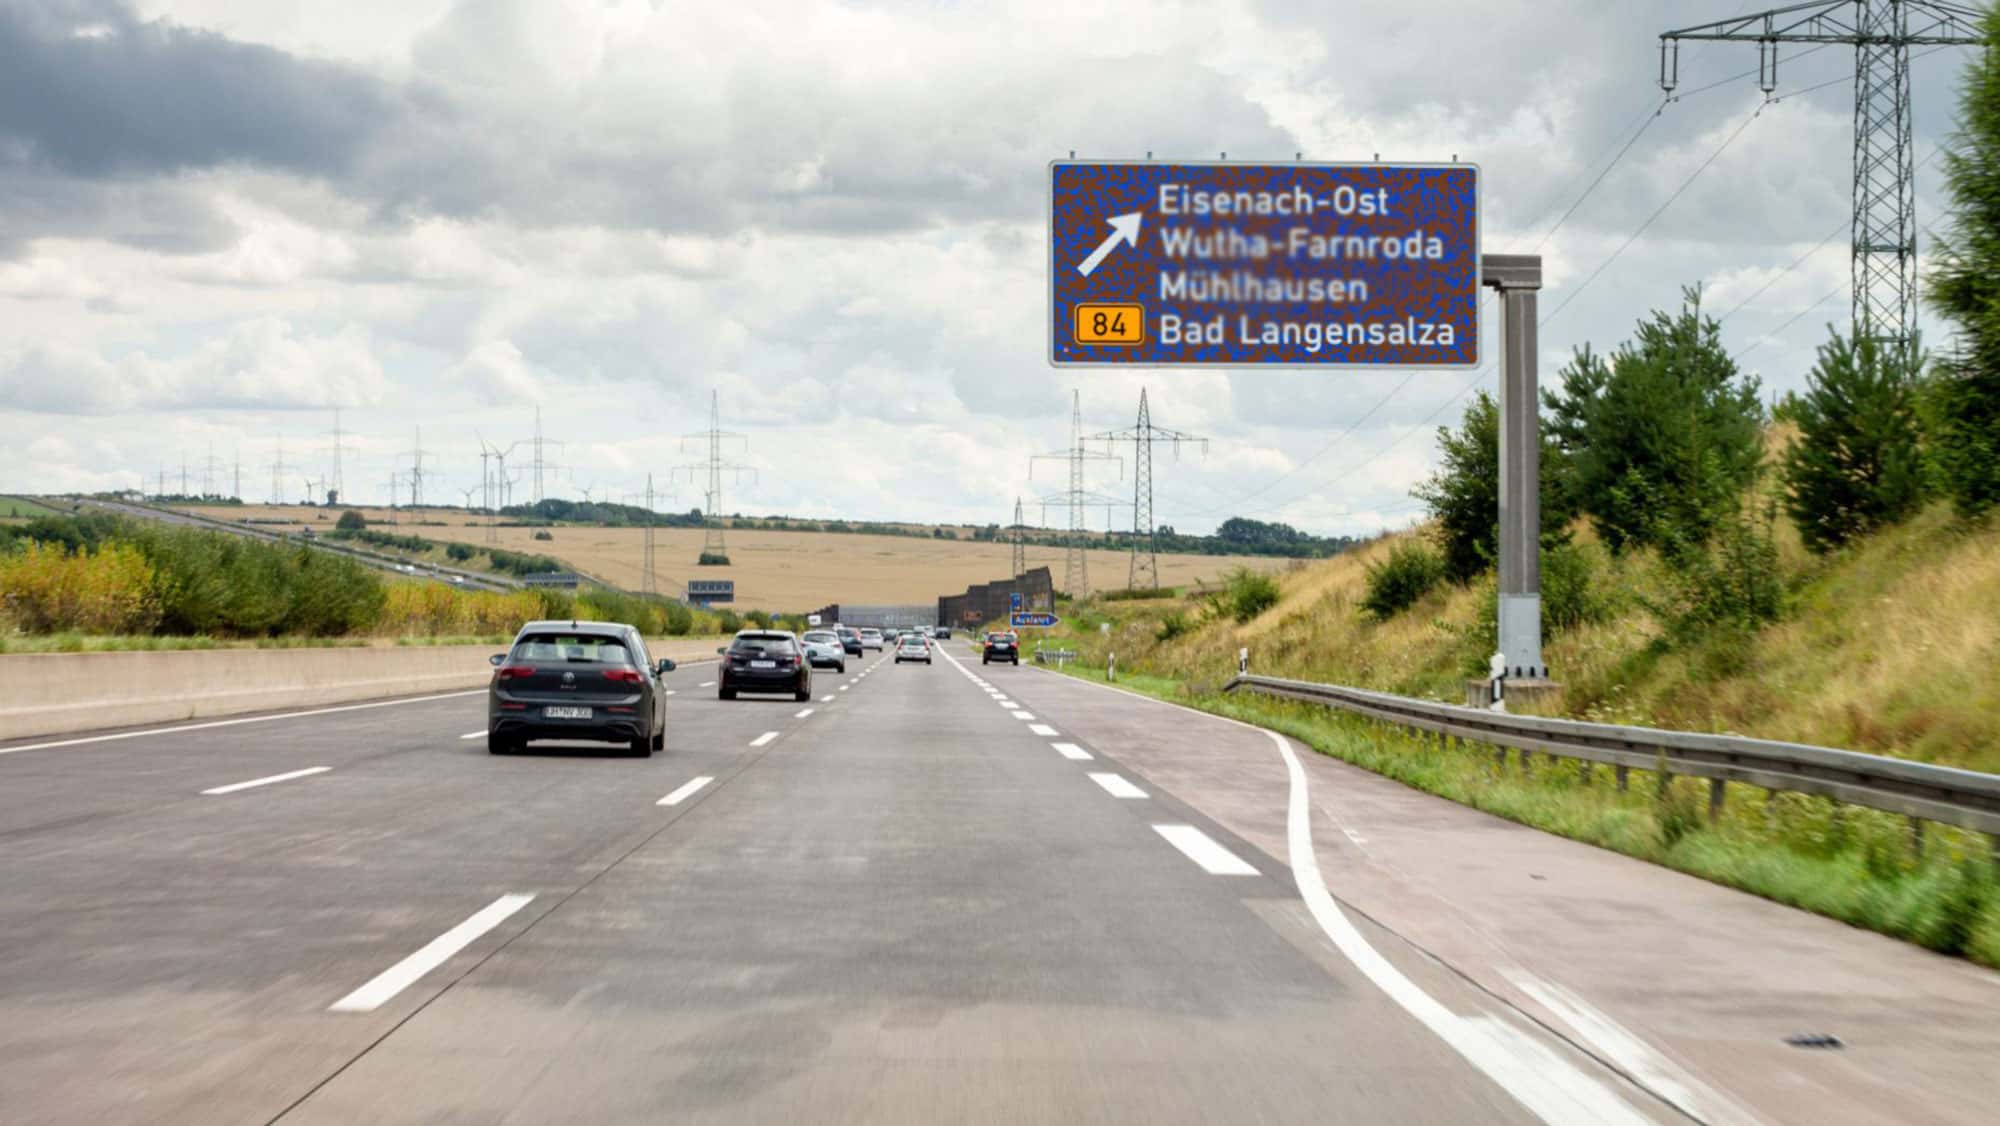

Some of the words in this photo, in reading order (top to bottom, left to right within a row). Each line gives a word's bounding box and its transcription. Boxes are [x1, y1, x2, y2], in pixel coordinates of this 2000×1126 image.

[1159, 184, 1388, 216] Eisenach-Ost
[1160, 228, 1443, 260] Wutha-Farnroda
[1160, 270, 1367, 302] Mühlhausen
[1093, 312, 1126, 336] 84
[1160, 314, 1224, 345] Bad
[1239, 315, 1455, 353] Langensalza
